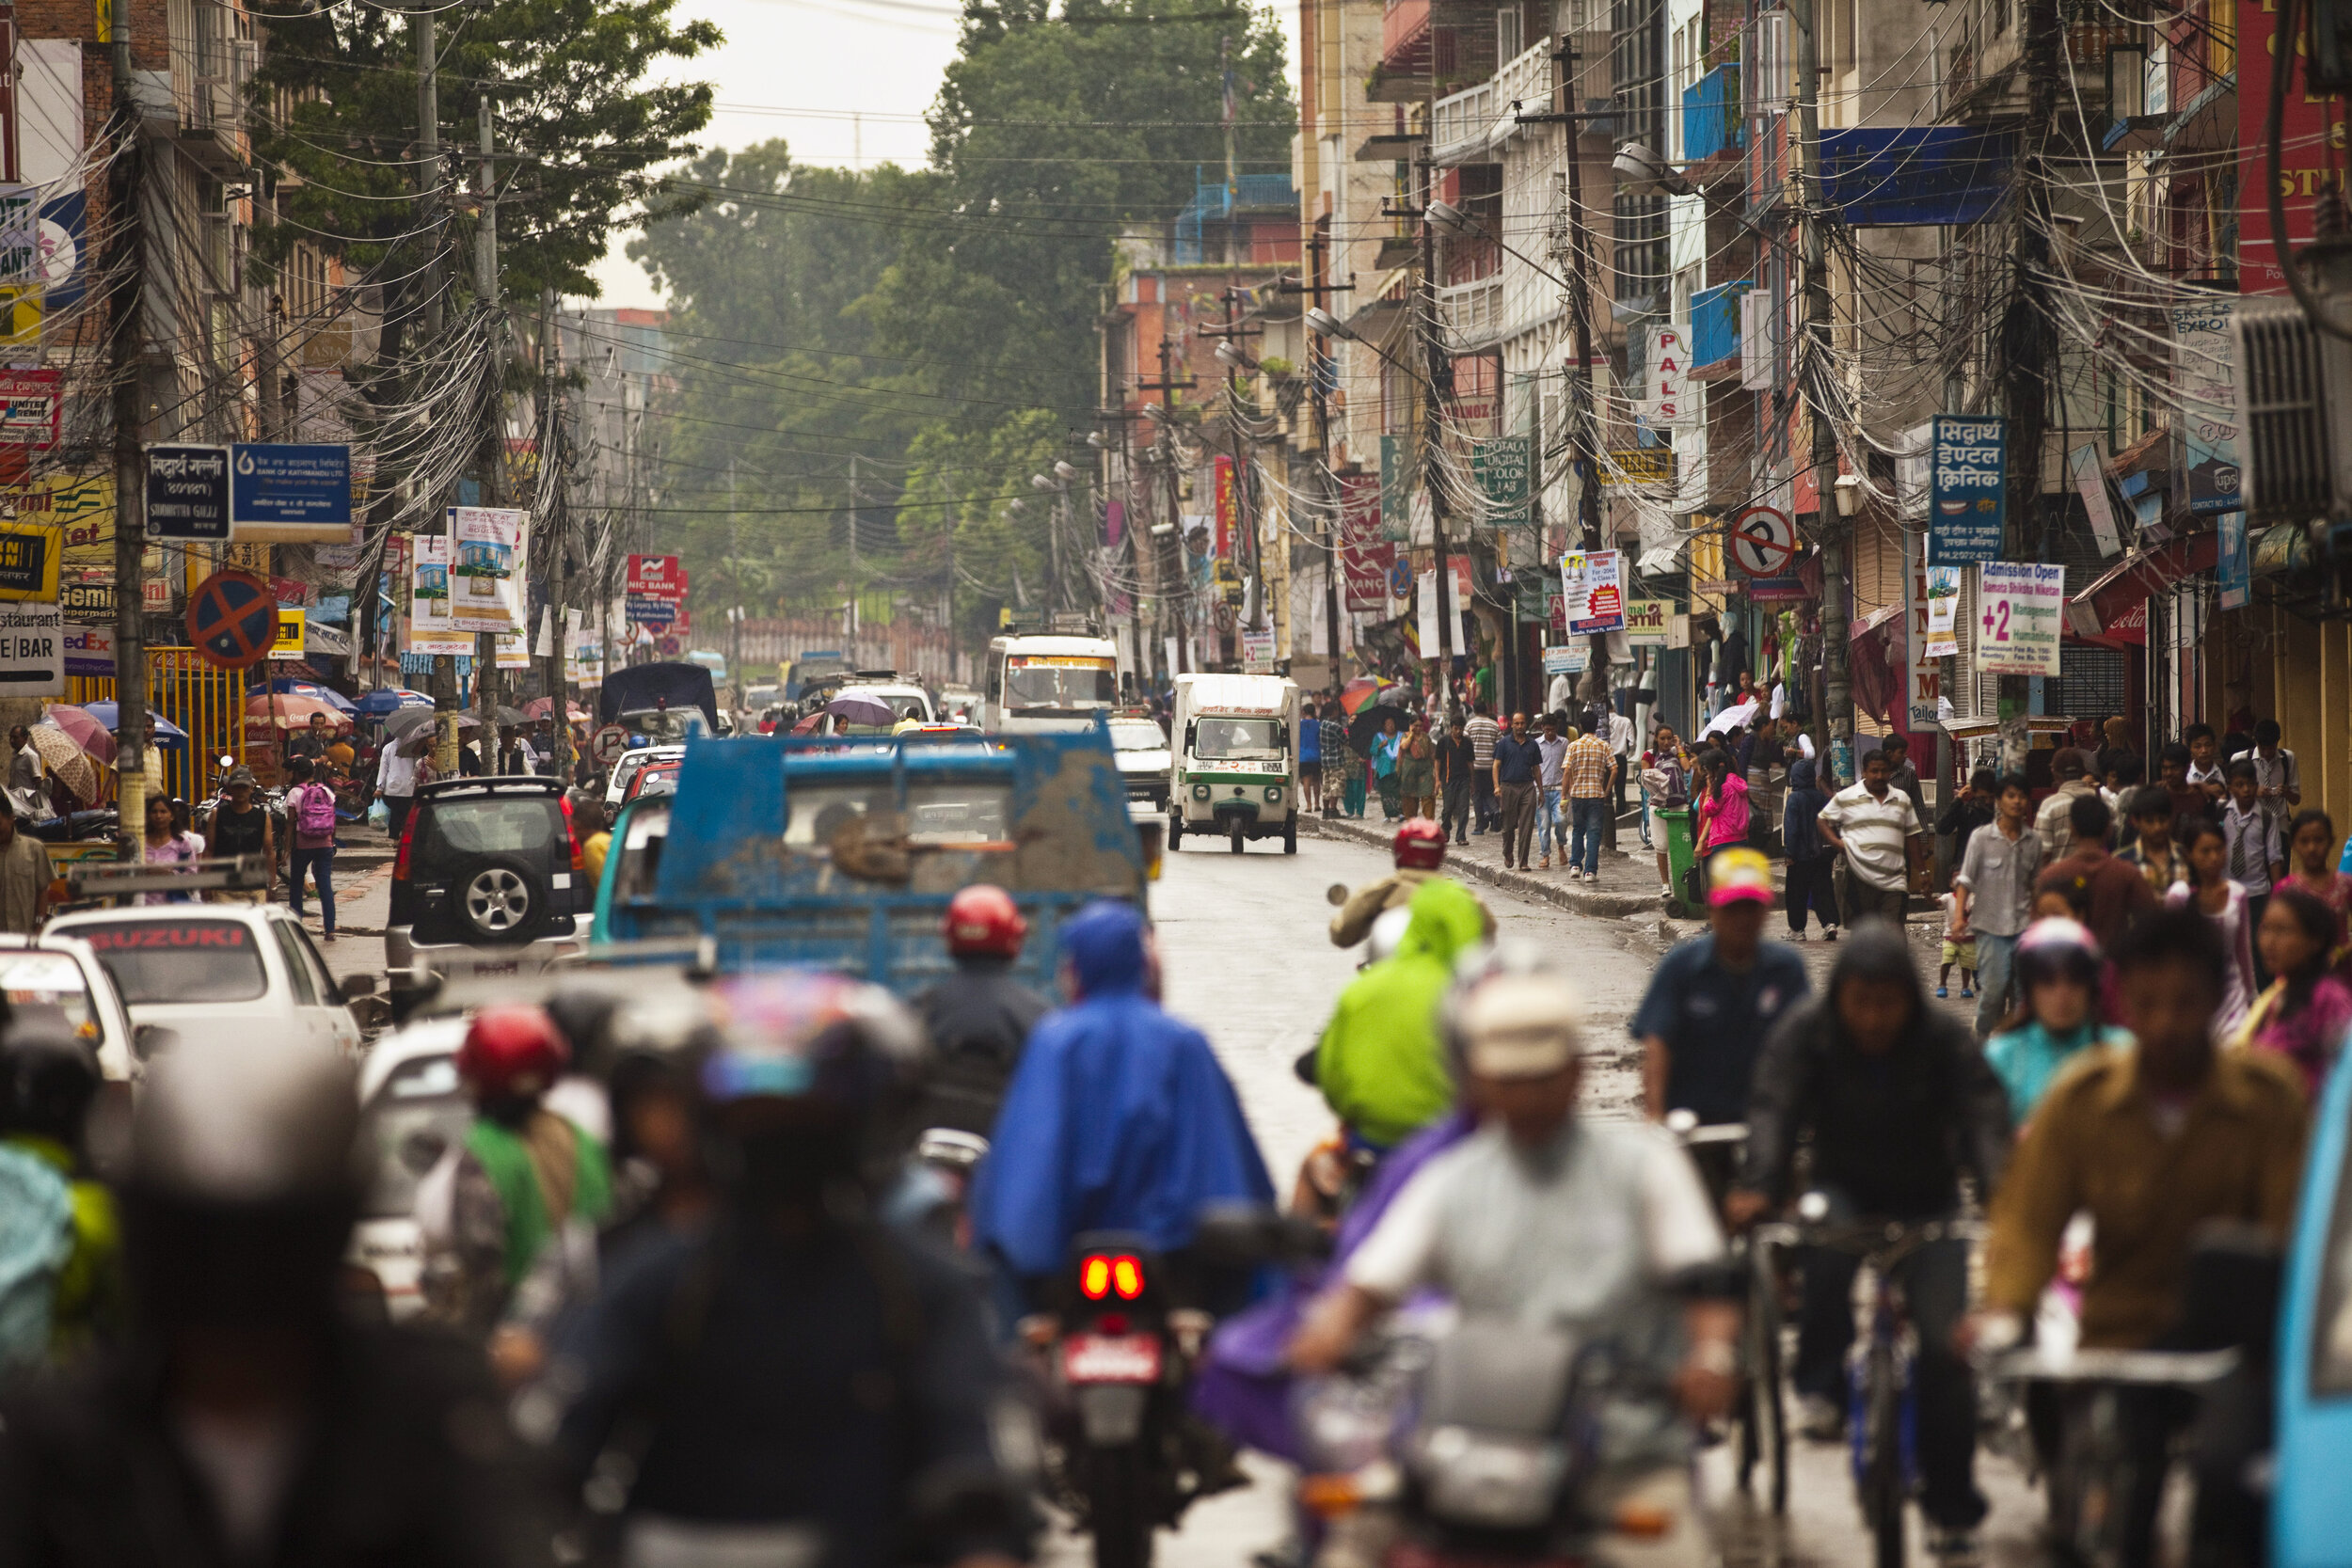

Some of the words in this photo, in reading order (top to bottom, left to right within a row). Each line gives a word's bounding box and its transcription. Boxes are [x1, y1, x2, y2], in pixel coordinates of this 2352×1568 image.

[2216, 475, 2238, 491] ups
[1982, 561, 2032, 578] Admission
[2035, 564, 2059, 582] Open
[628, 580, 646, 589] NIC
[647, 581, 676, 591] BANK
[1753, 593, 1778, 601] Everest
[2012, 602, 2058, 620] Management
[1982, 599, 2010, 642] +2
[2012, 628, 2056, 643] Humanities
[87, 927, 244, 952] SUZUKI
